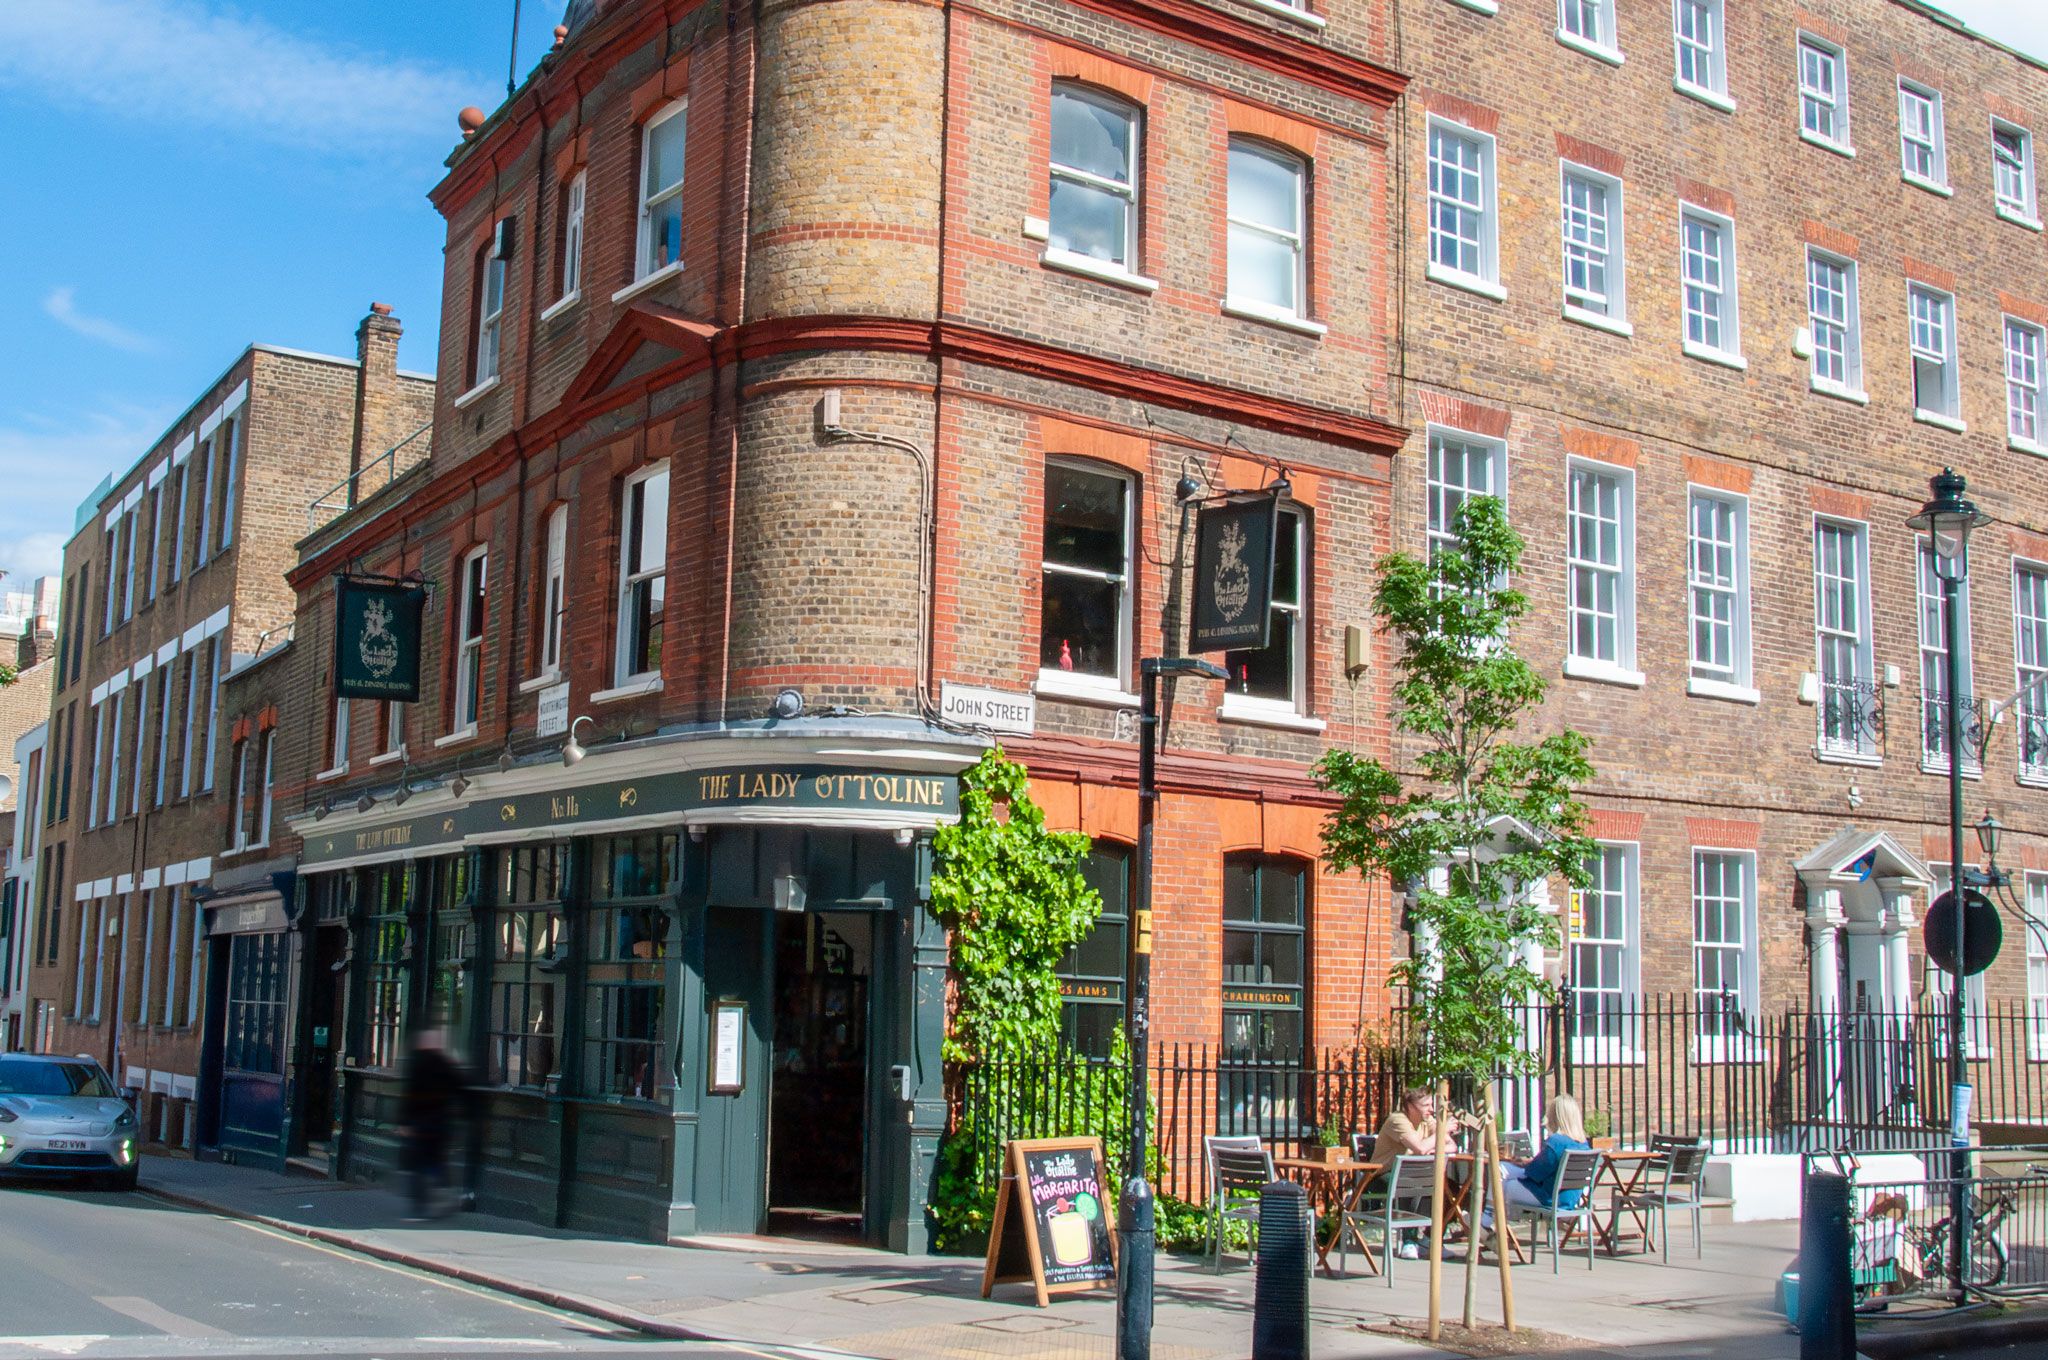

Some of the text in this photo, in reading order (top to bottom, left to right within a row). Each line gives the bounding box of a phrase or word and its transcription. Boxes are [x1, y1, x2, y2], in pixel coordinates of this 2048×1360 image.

[945, 695, 1032, 723] JOHN STREET
[699, 772, 945, 806] THE LADY OTTOLINE
[1076, 985, 1108, 997] ARMS
[1222, 991, 1291, 1003] CHARRINGTON
[1055, 1153, 1075, 1167] Lady
[1032, 1177, 1099, 1206] MARGARITA
